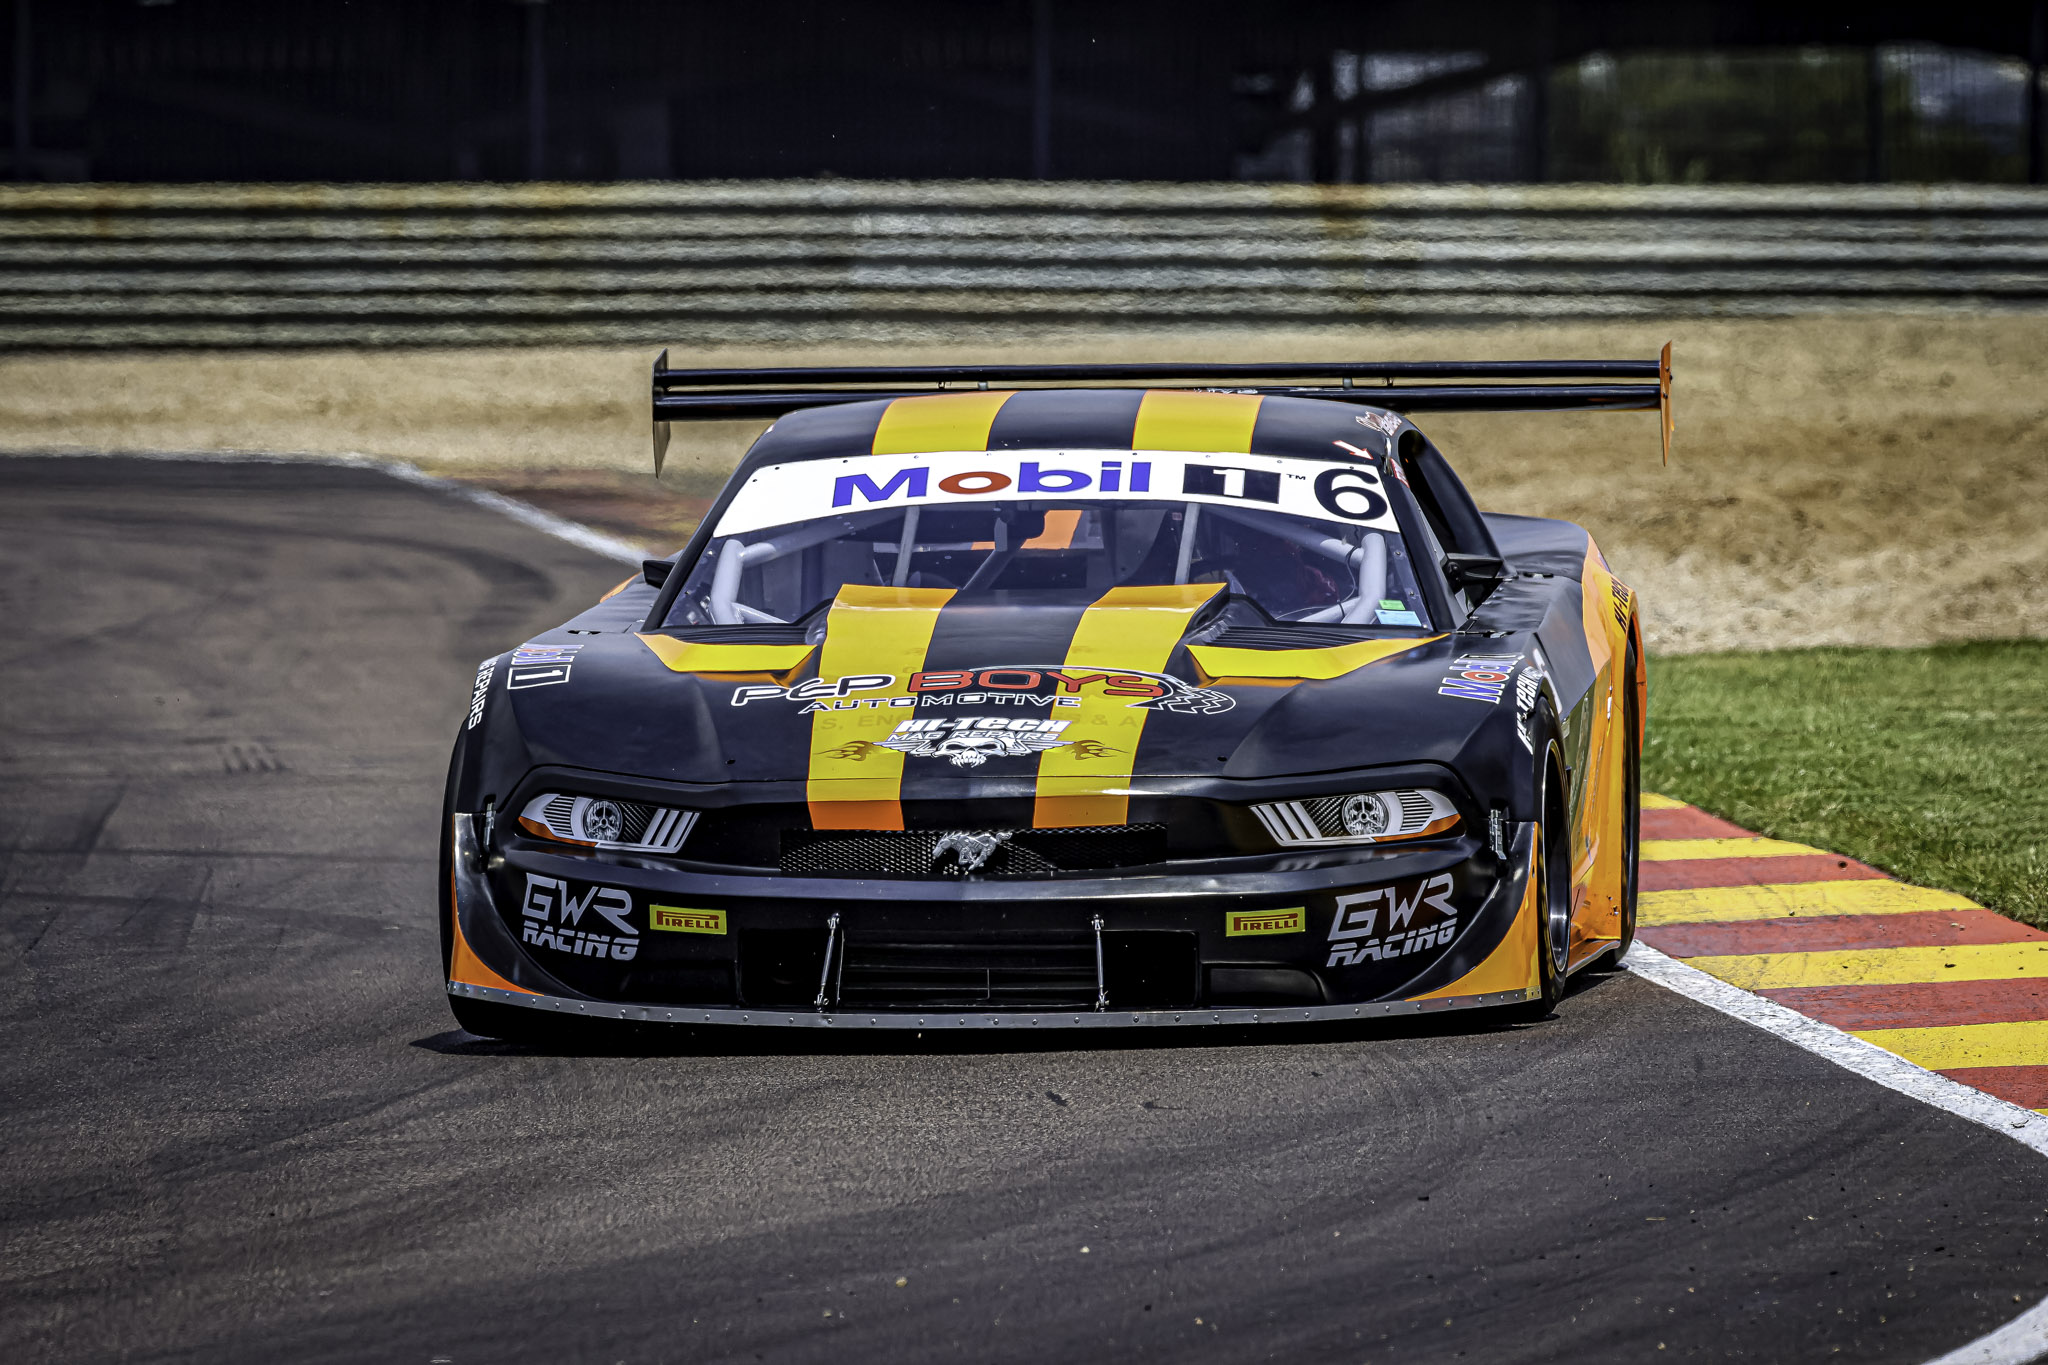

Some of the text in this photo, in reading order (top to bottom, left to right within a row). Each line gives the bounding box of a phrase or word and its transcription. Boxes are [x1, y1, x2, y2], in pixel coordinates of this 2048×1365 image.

[832, 461, 1152, 508] Mobil
[1314, 468, 1388, 520] 6
[468, 665, 496, 730] REPAIRS
[798, 693, 1082, 714] AUTOMOTIVE
[908, 670, 1164, 697] BOYS
[886, 730, 1062, 742] MAG REPAIRS
[522, 872, 639, 935] GWR
[656, 910, 720, 930] PIRELLI
[1233, 912, 1298, 931] PIRELLI
[1327, 873, 1457, 941] GWR
[523, 920, 640, 961] RACING
[1326, 917, 1457, 967] RACING
